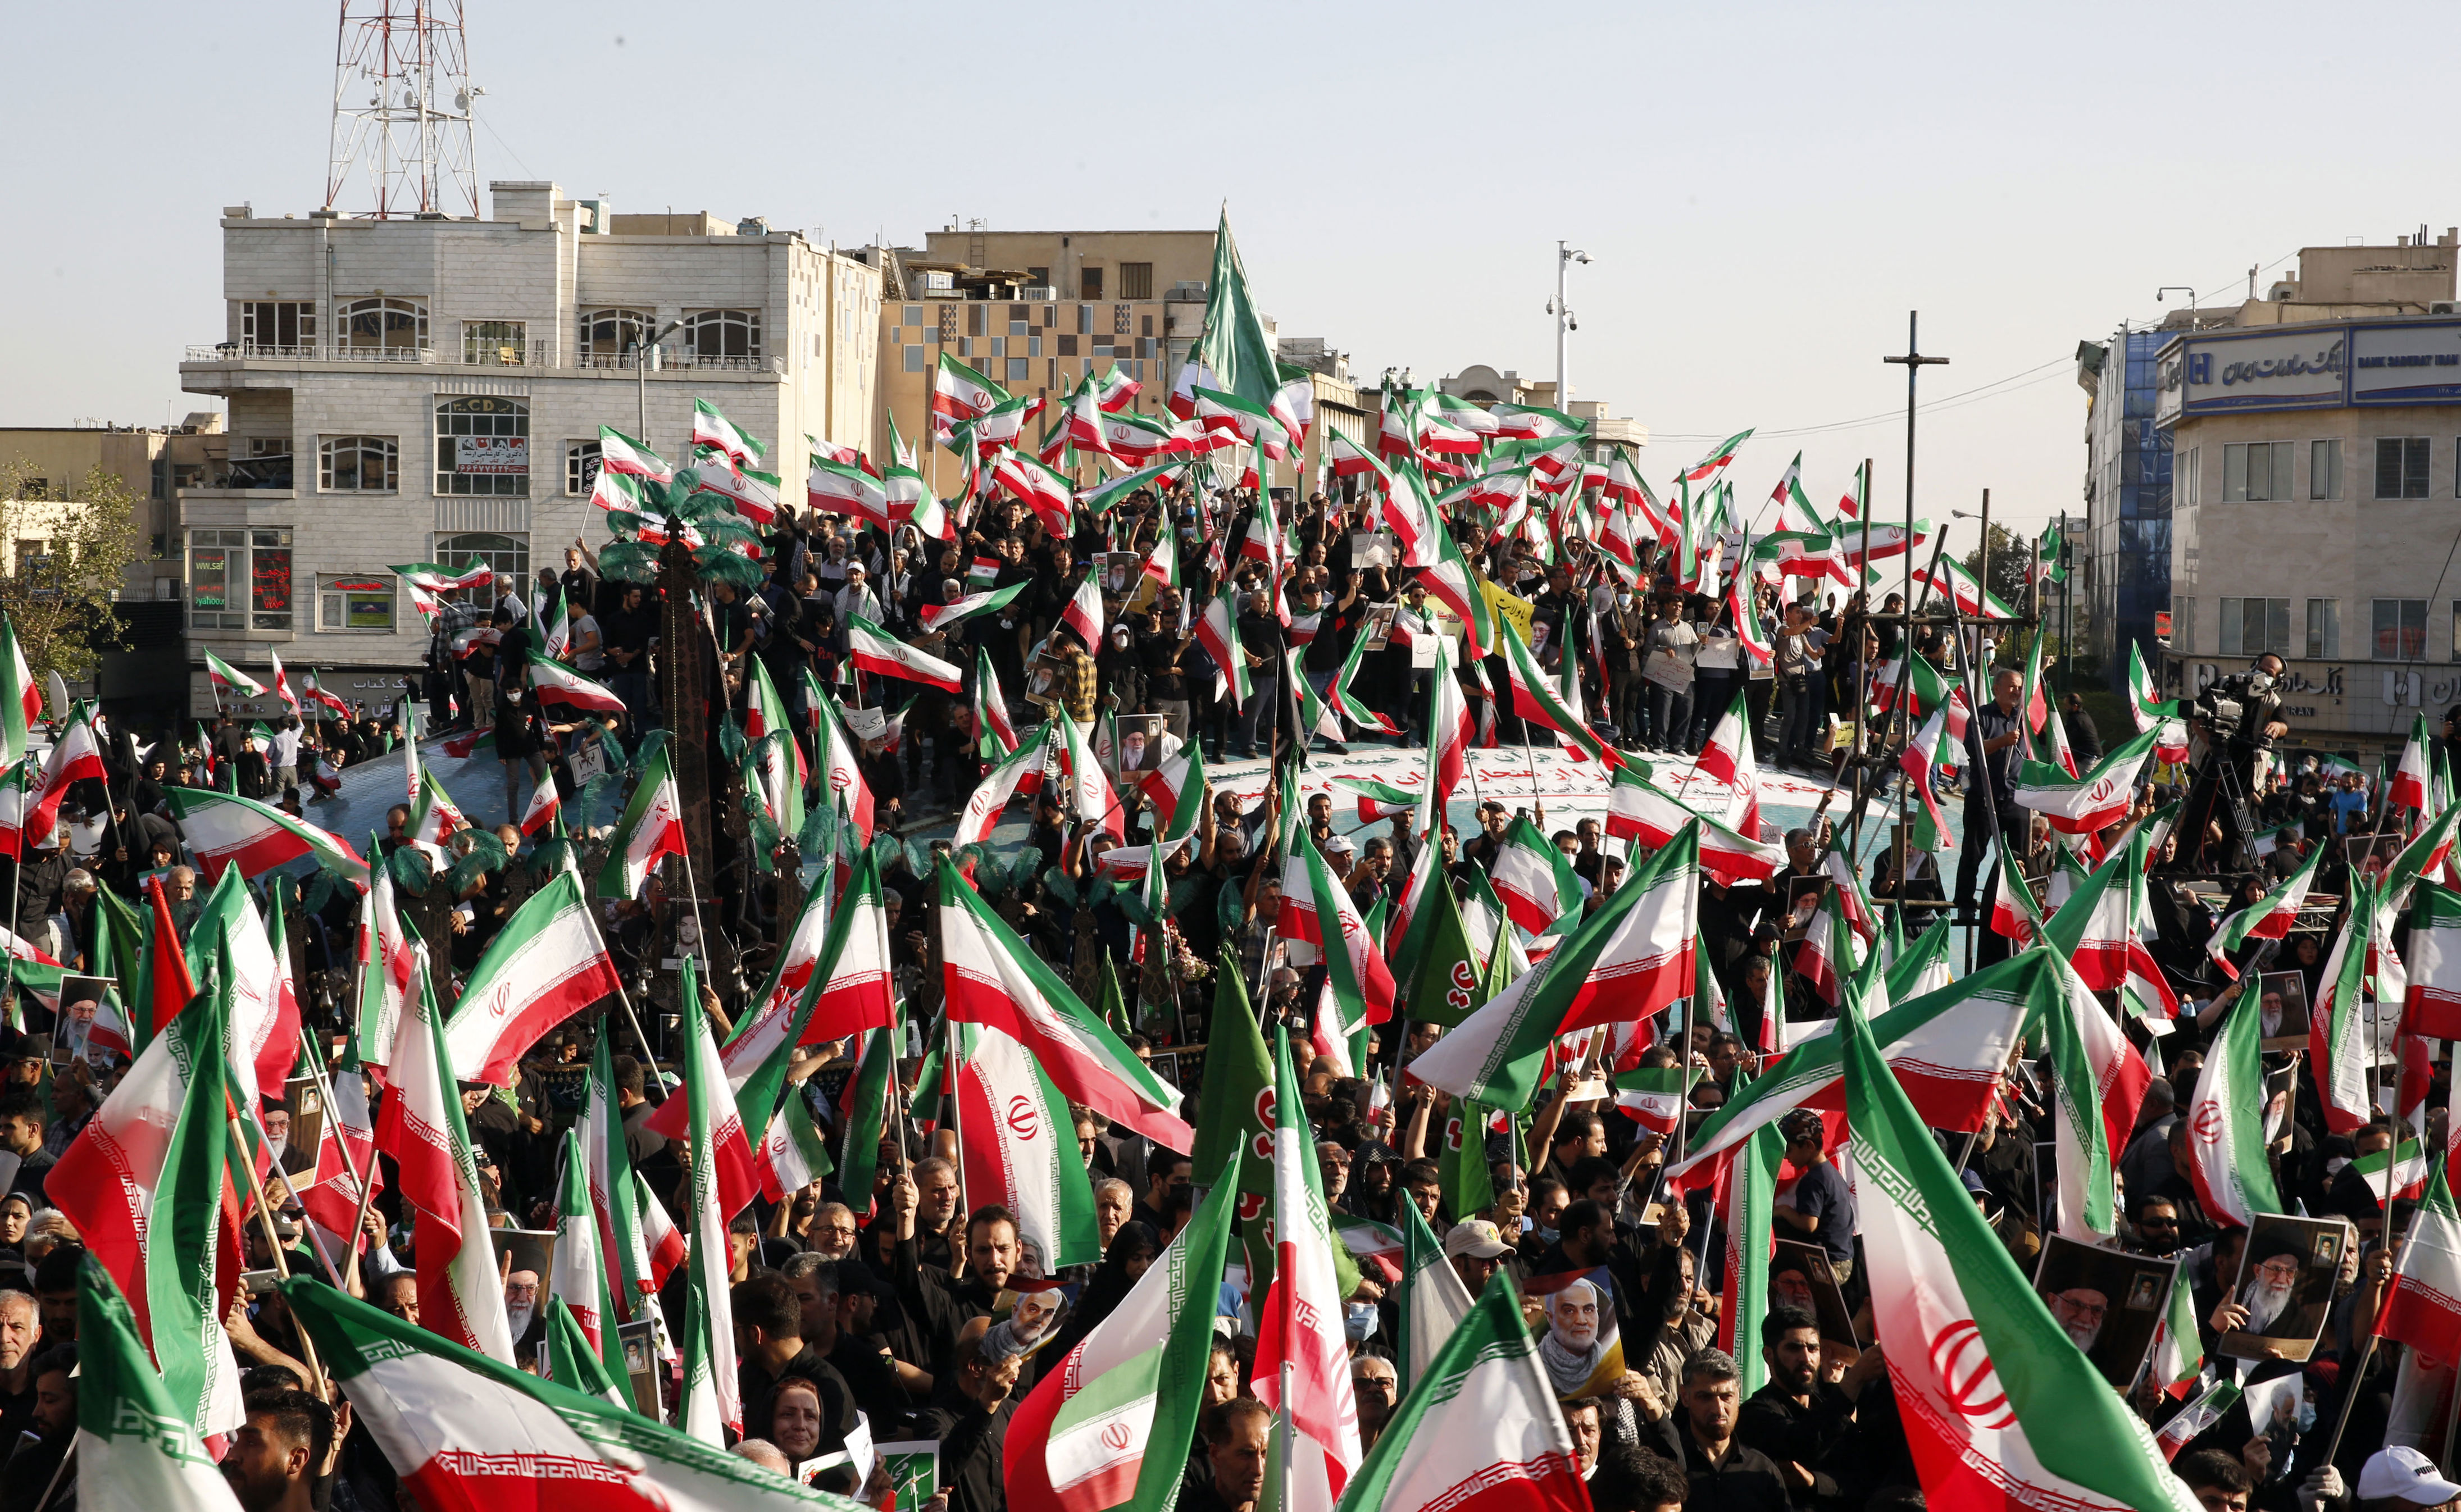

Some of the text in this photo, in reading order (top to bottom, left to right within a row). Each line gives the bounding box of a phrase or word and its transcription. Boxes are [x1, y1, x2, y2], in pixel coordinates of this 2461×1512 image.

[2358, 357, 2386, 368] BANK
[2435, 354, 2459, 366] IRAN
[353, 678, 386, 691] کتاب
[1343, 754, 1400, 767] خیمه
